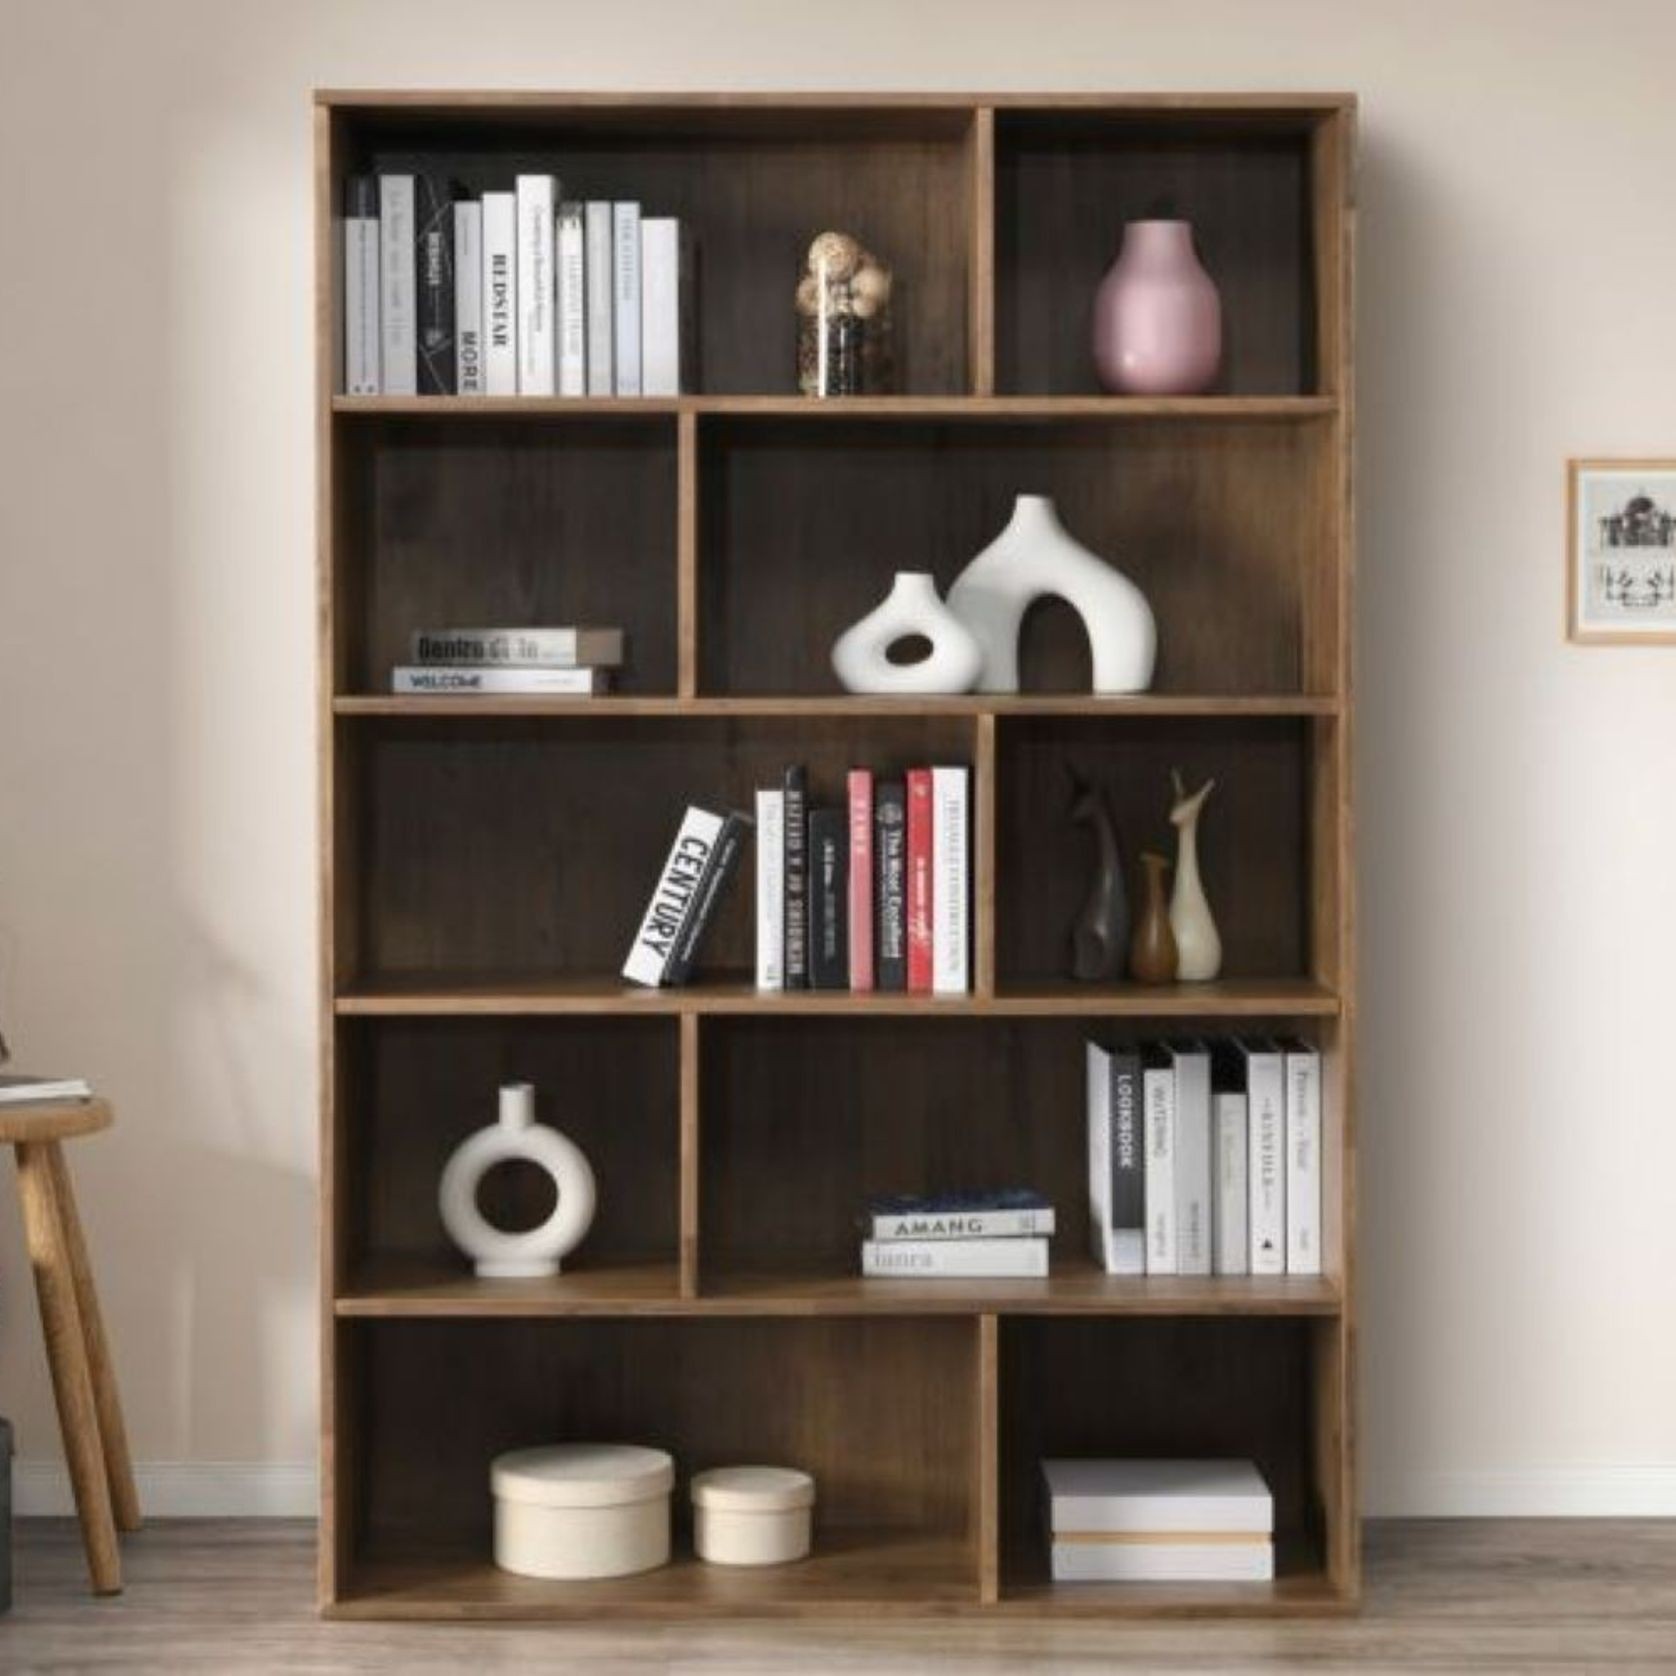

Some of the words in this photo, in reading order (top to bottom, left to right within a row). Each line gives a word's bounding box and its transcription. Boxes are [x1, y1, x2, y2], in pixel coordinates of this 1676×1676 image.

[492, 254, 508, 347] REDSTAR
[460, 331, 478, 391] MORE
[642, 836, 709, 958] CENTURY
[1116, 1074, 1134, 1169] LOOKBOOK
[894, 1217, 983, 1237] AMANG
